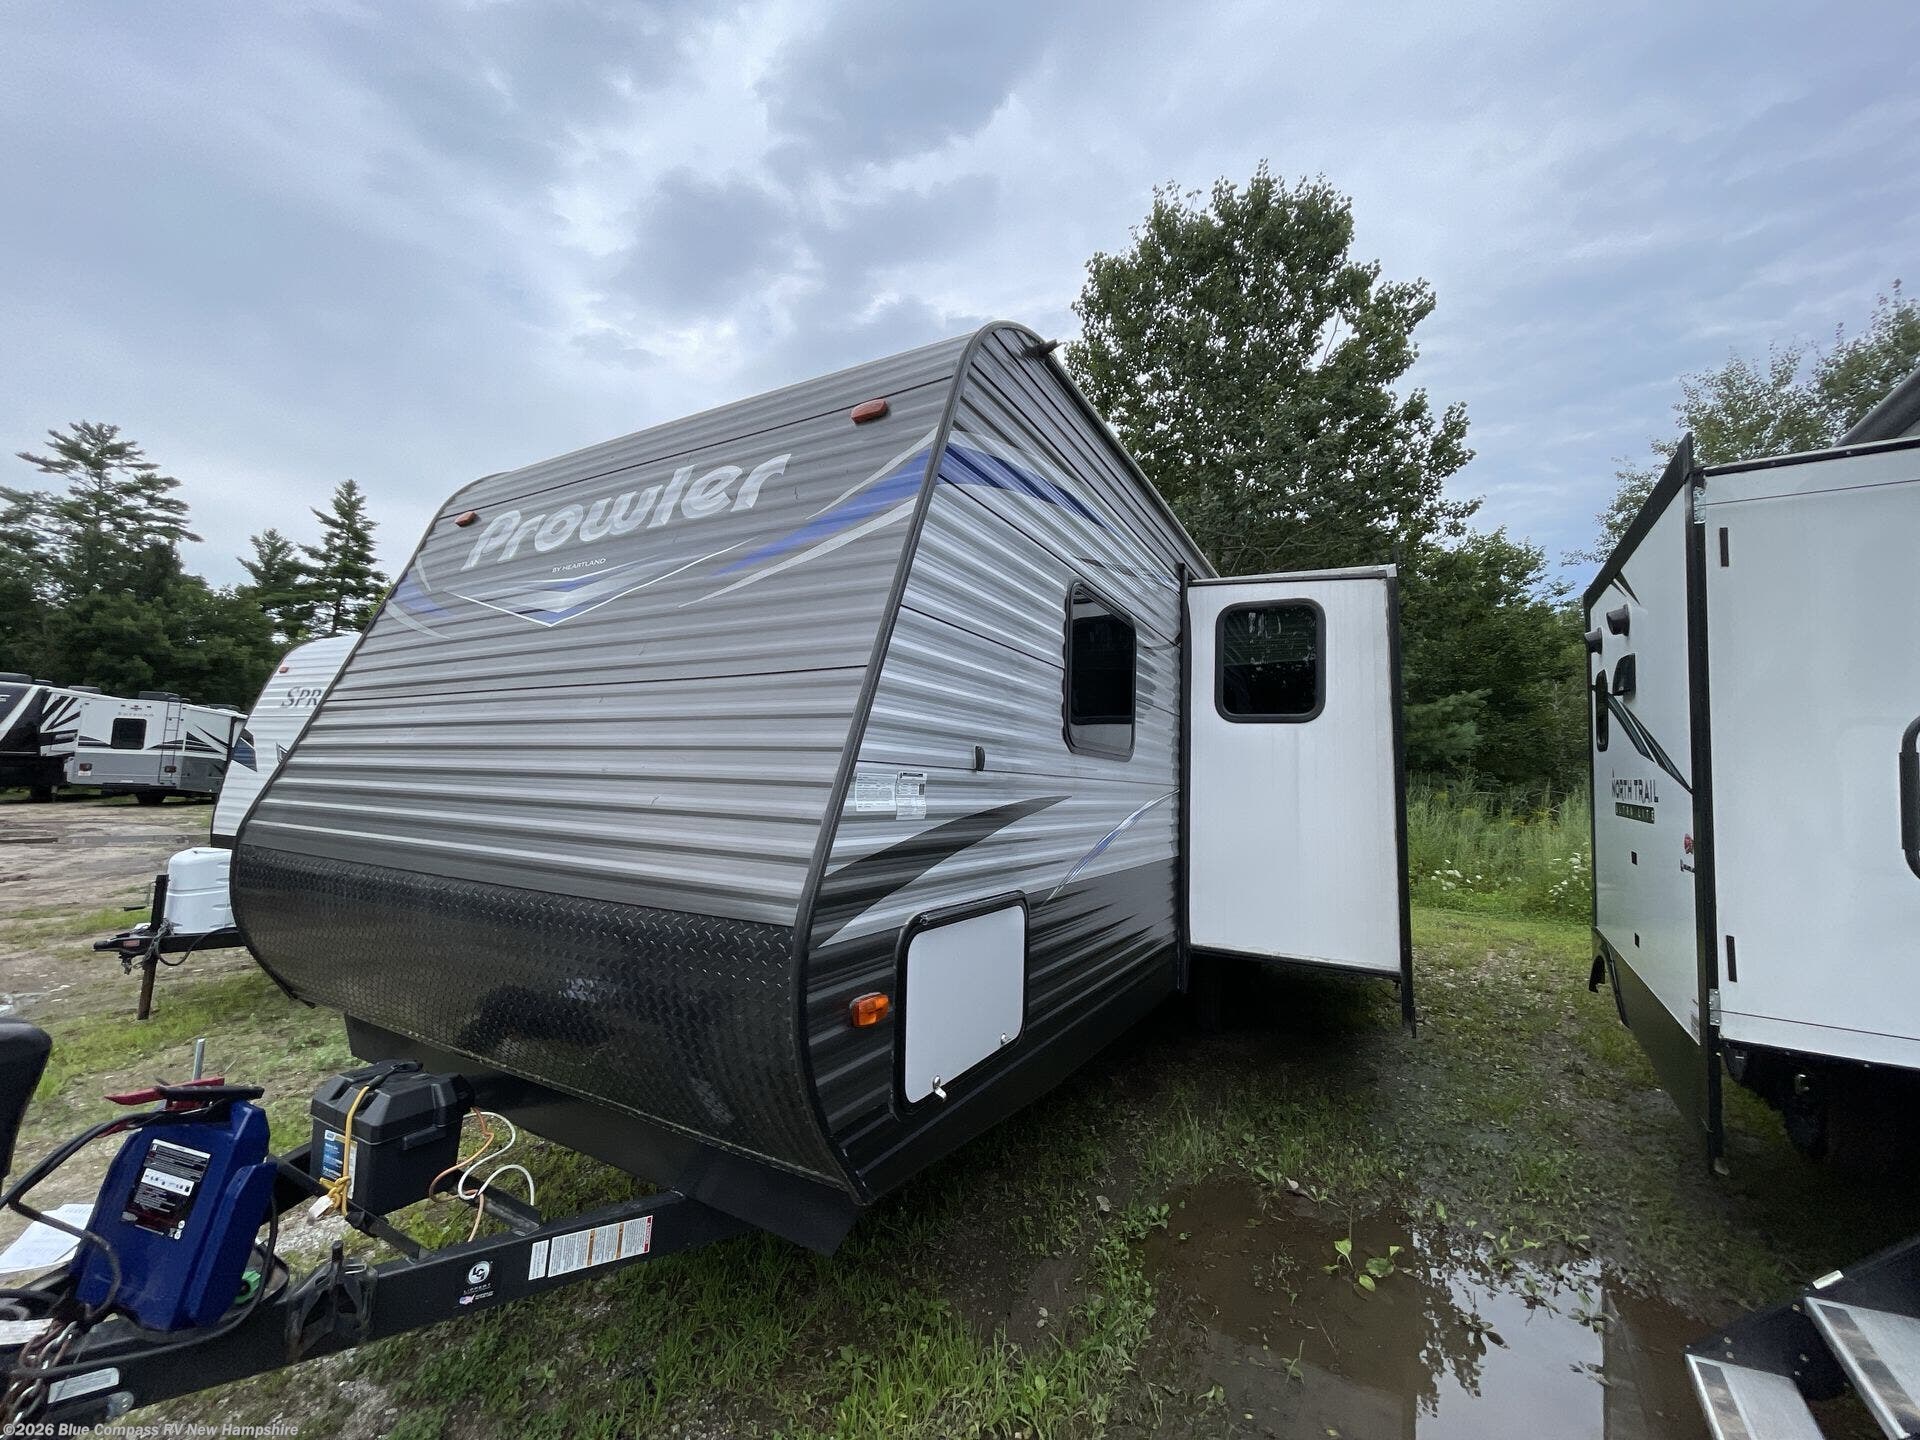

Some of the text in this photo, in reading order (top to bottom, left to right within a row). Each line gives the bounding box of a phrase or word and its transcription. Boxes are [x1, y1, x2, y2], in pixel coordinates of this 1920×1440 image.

[460, 453, 792, 572] Prowler
[561, 557, 607, 571] HEARTLAND
[1633, 778, 1659, 804] TRAIL
